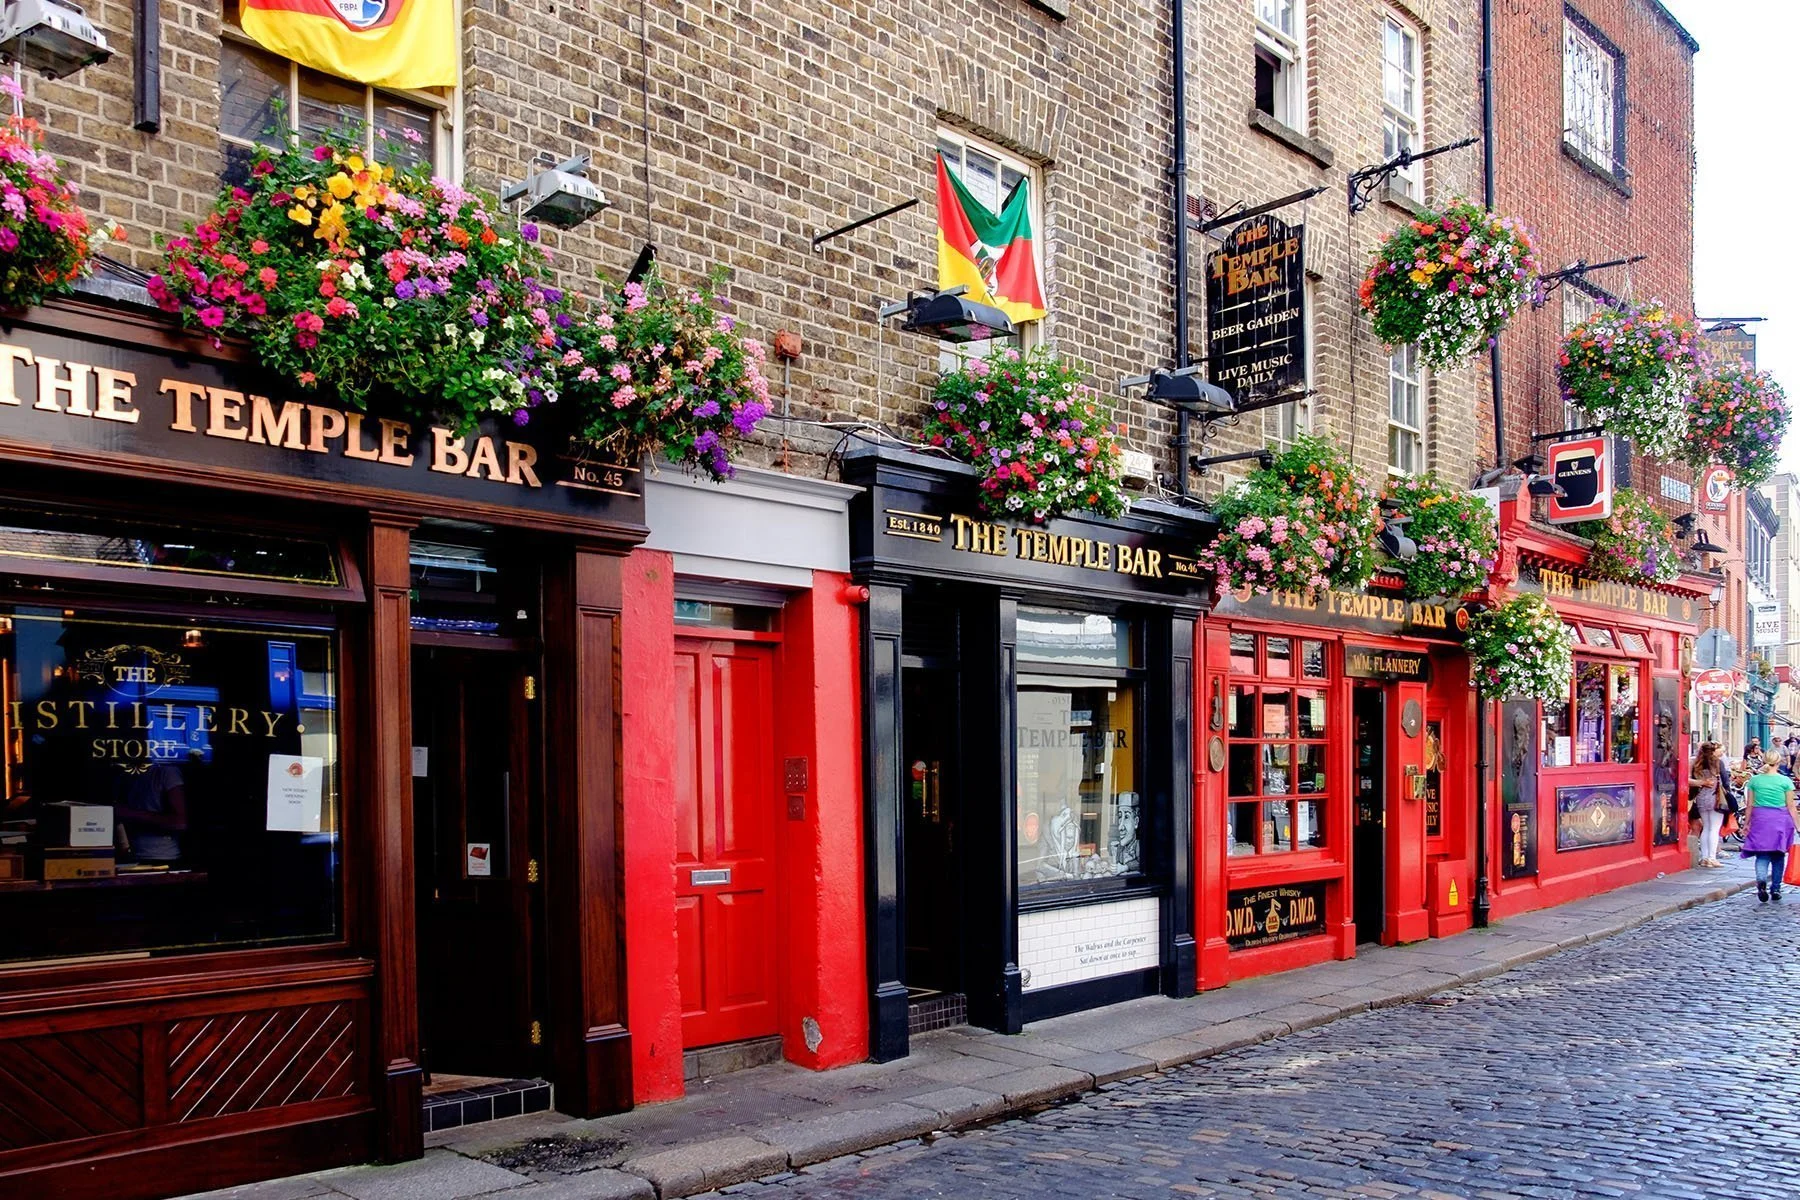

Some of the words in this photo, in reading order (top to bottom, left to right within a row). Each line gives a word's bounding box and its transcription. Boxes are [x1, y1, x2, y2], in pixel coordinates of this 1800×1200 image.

[1236, 224, 1268, 246] THE
[1212, 237, 1299, 279] TEMPLE
[1227, 265, 1280, 295] BAR
[1212, 323, 1244, 340] BEER
[1247, 308, 1299, 331] GARDEN
[1218, 365, 1248, 381] LIVE
[1251, 354, 1293, 373] MUSIC
[1237, 369, 1276, 388] DAILY
[0, 343, 140, 424] THE
[160, 378, 414, 468] TEMPLE
[431, 426, 541, 487] BAR
[574, 466, 600, 483] No.
[603, 470, 623, 487] 45
[1558, 468, 1592, 478] GUINNESS
[950, 513, 1007, 556] THE
[1016, 528, 1111, 571] TEMPLE
[1117, 544, 1162, 578] BAR
[1539, 568, 1573, 597] THE
[1578, 578, 1638, 611] TEMPLE
[1643, 591, 1668, 616] BAR
[1324, 589, 1405, 622] TEMPLE
[1411, 602, 1447, 629] BAR
[113, 666, 156, 682] THE
[1354, 654, 1372, 671] WM.
[1374, 657, 1421, 674] FLANNERY
[9, 700, 284, 737] ISTILLERY
[92, 738, 178, 758] STORE
[1017, 727, 1088, 748] TEMPLE
[1094, 729, 1128, 748] BAR
[1243, 896, 1256, 906] THE
[1258, 890, 1278, 901] FINEST
[1279, 888, 1301, 897] WHISKY
[1226, 907, 1256, 936] D.W.D.
[1290, 897, 1316, 925] D.W.D.
[1104, 940, 1114, 948] and
